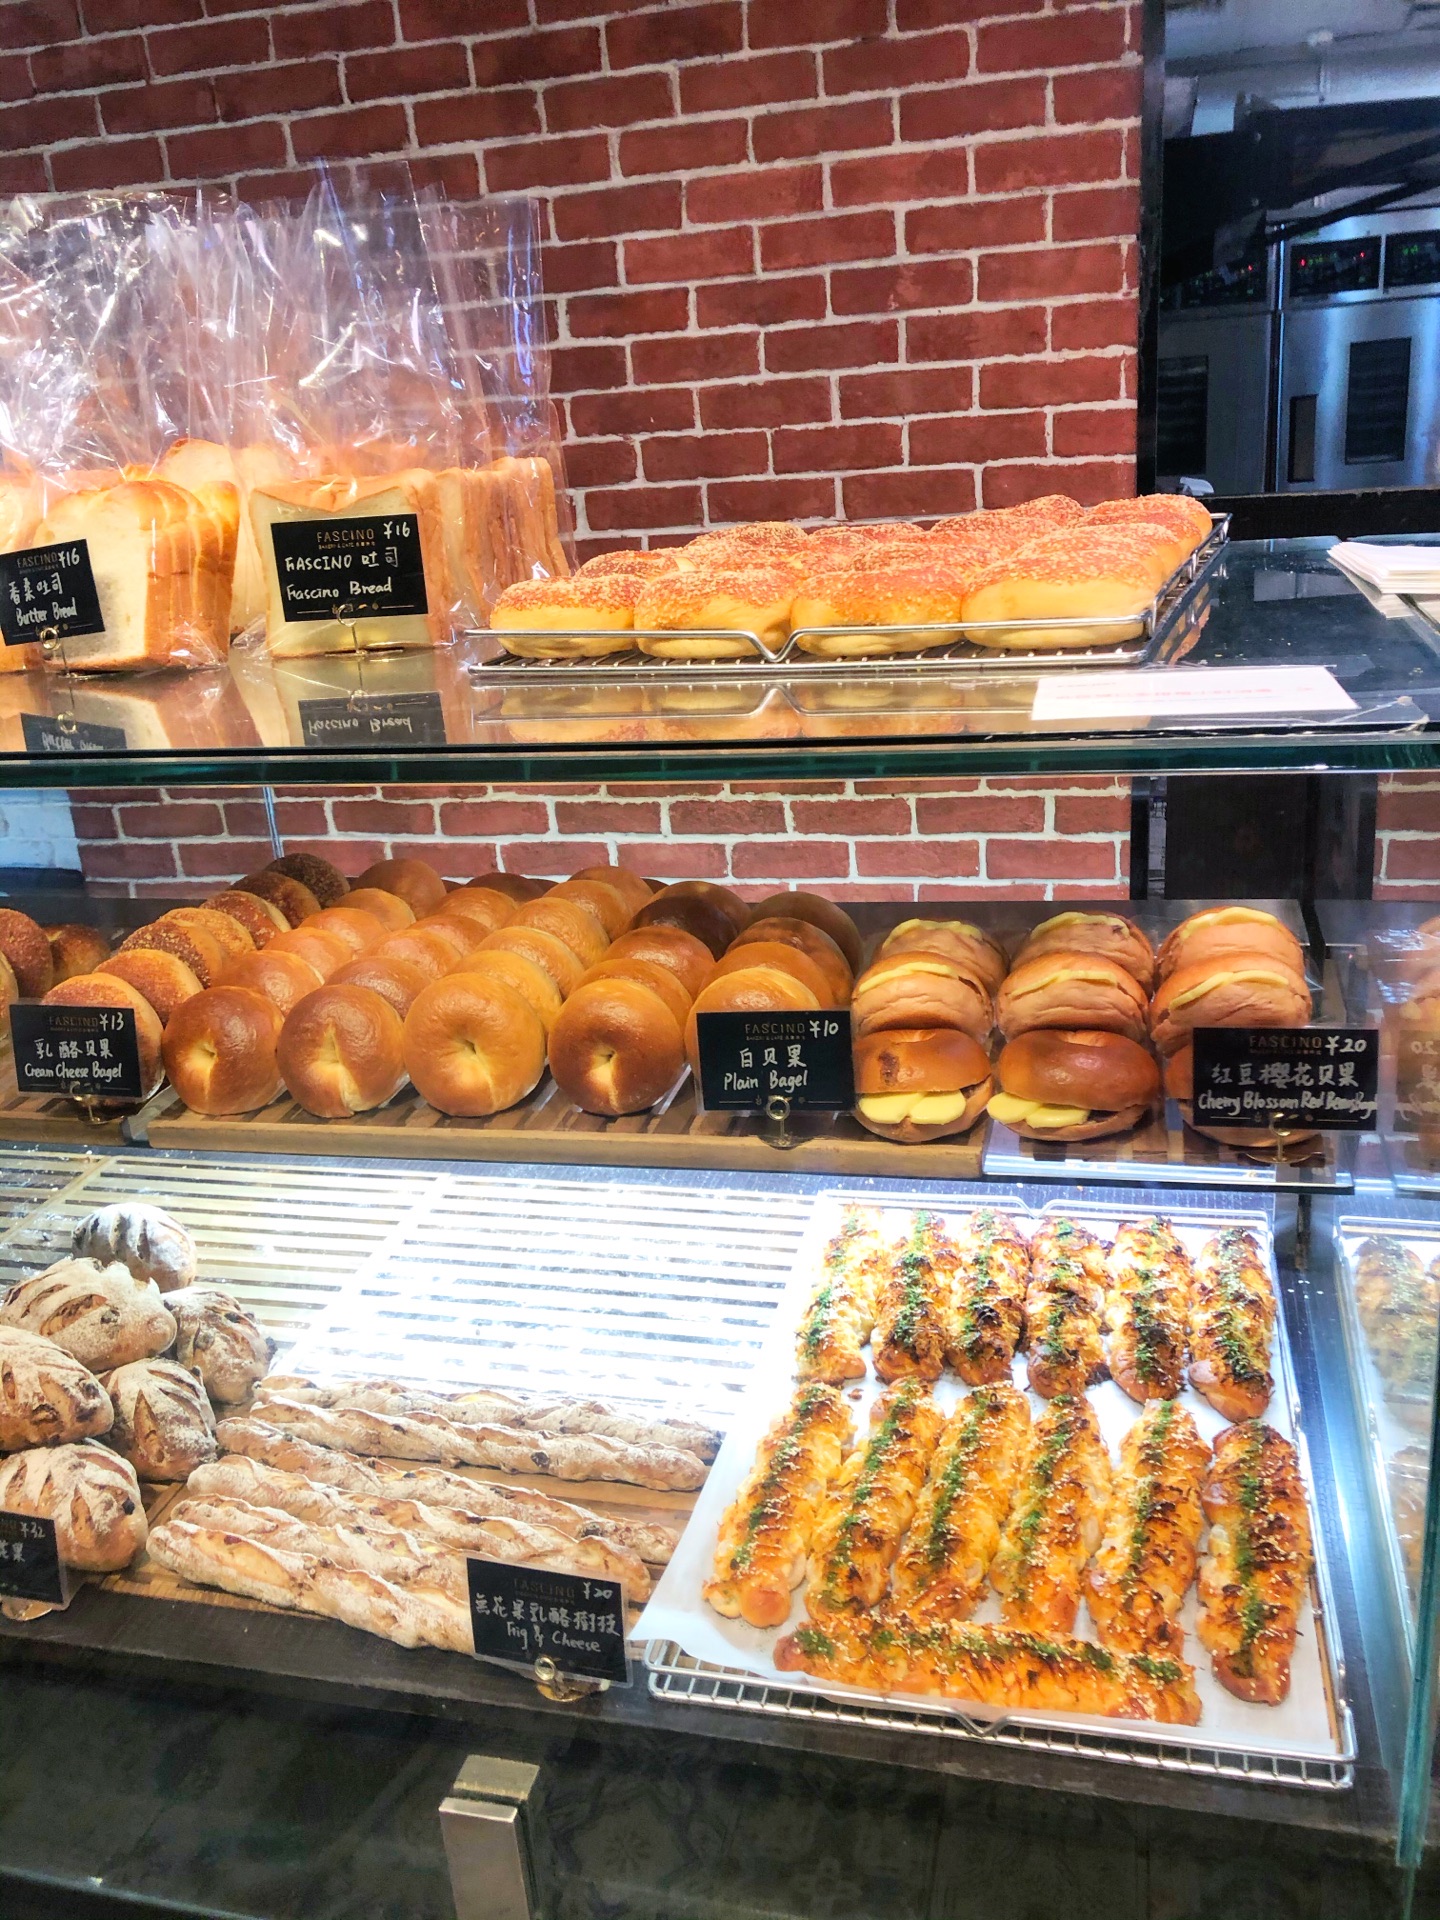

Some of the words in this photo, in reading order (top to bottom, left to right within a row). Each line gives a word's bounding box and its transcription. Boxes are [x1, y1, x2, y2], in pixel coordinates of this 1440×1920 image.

[316, 528, 375, 543] FASCINO
[383, 521, 411, 540] ¥16
[17, 551, 59, 569] FASCINO
[58, 547, 80, 569] ¥16
[285, 554, 353, 572] FASCINO
[361, 546, 399, 568] 吐司
[286, 584, 340, 601] Fascino
[349, 576, 393, 595] Bread
[16, 606, 48, 627] Butter
[51, 596, 78, 620] Bread
[99, 1012, 125, 1032] ¥13
[744, 1022, 806, 1035] FASCINO
[808, 1019, 840, 1039] ¥10
[1249, 1035, 1323, 1049] FASCINO
[1324, 1035, 1368, 1056] ¥20
[24, 1063, 55, 1078] Cream
[55, 1061, 89, 1079] Cheese
[91, 1061, 123, 1083] Bagel
[723, 1072, 759, 1091] Plain
[768, 1070, 809, 1094] Bagel
[1198, 1089, 1241, 1116] Cherry
[1242, 1092, 1299, 1110] Blossom
[1300, 1090, 1326, 1109] Red
[582, 1581, 614, 1600] ¥20
[551, 1630, 602, 1653] Cheese
